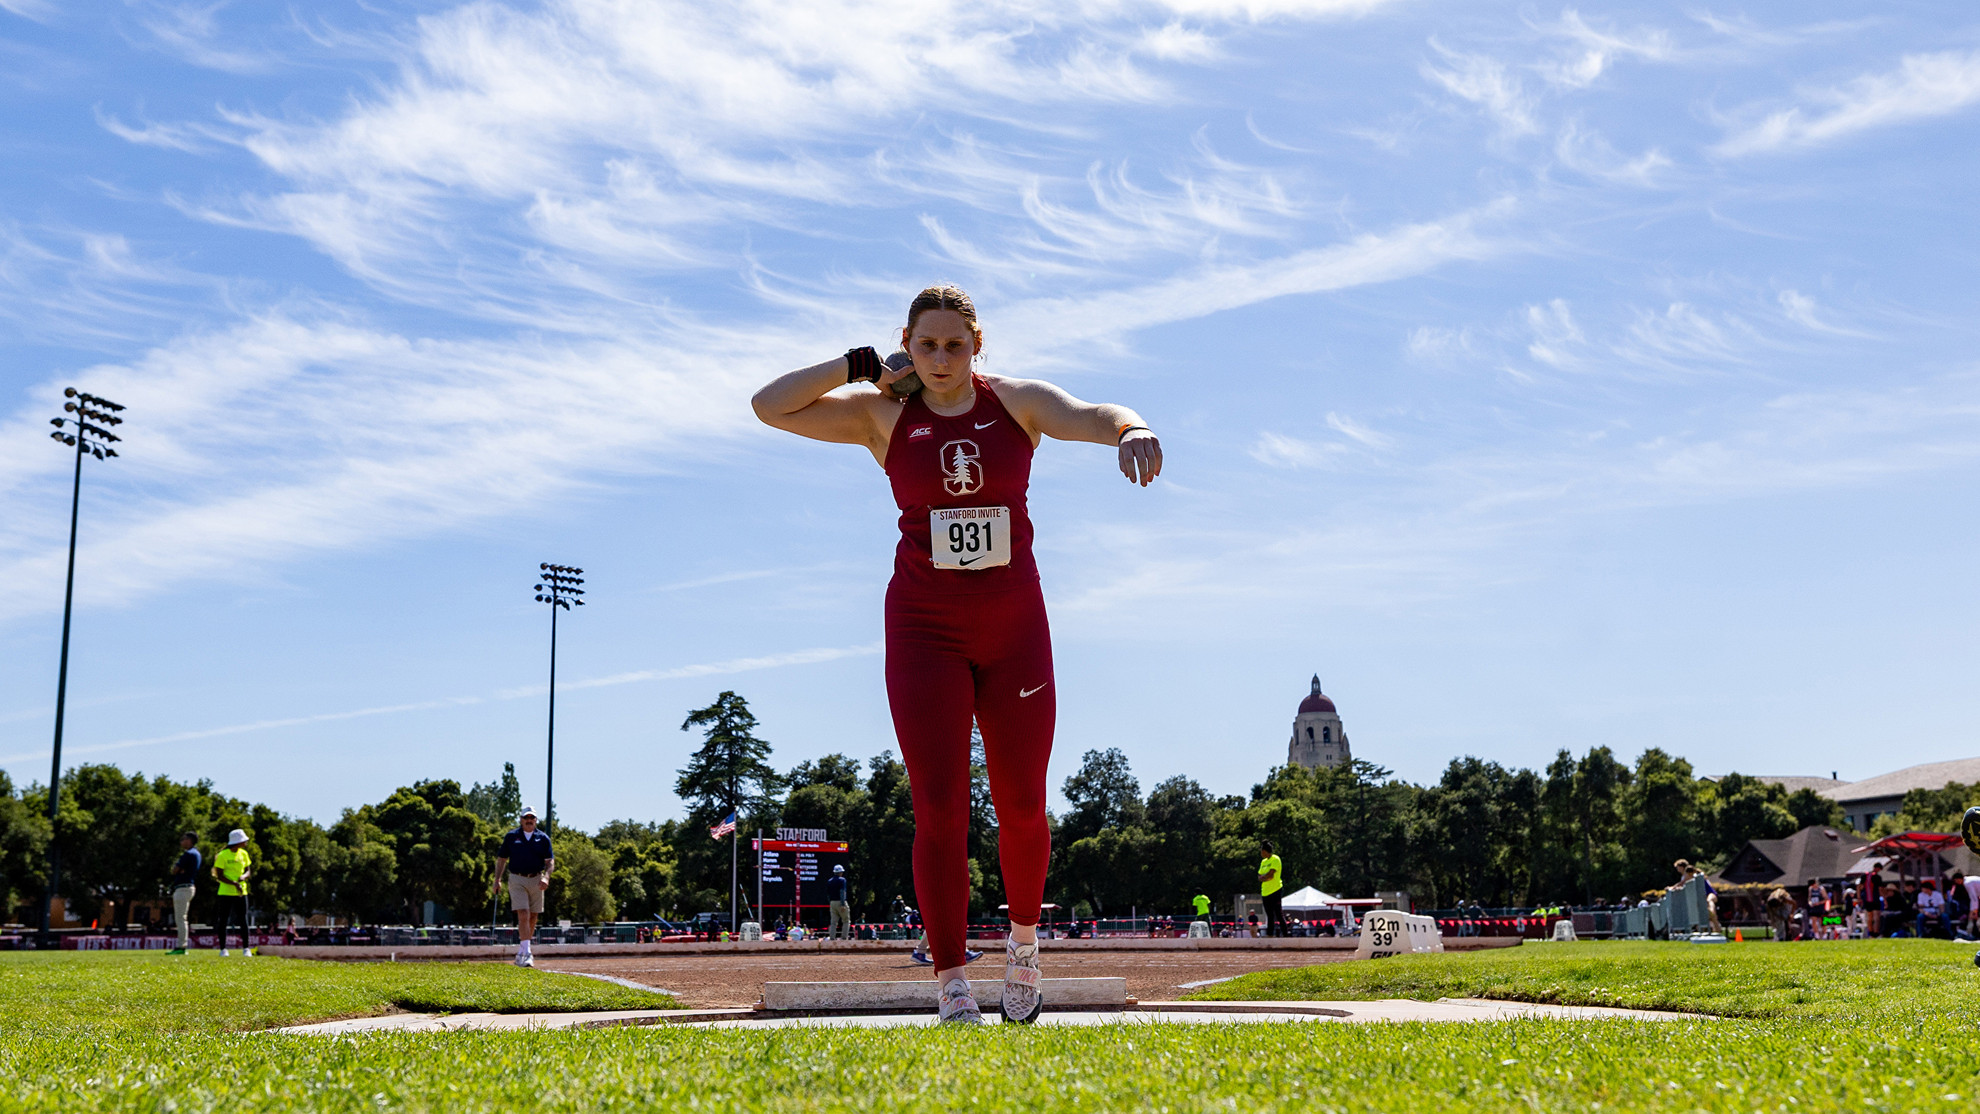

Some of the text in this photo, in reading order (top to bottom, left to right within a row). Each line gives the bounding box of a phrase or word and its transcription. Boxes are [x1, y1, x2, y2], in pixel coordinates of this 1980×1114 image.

[910, 427, 931, 438] ACC
[940, 508, 1001, 520] STANFORD INVITE
[949, 522, 992, 553] 931
[776, 827, 827, 841] STANFORD
[1369, 917, 1400, 932] 12m
[1373, 932, 1398, 946] 39'
